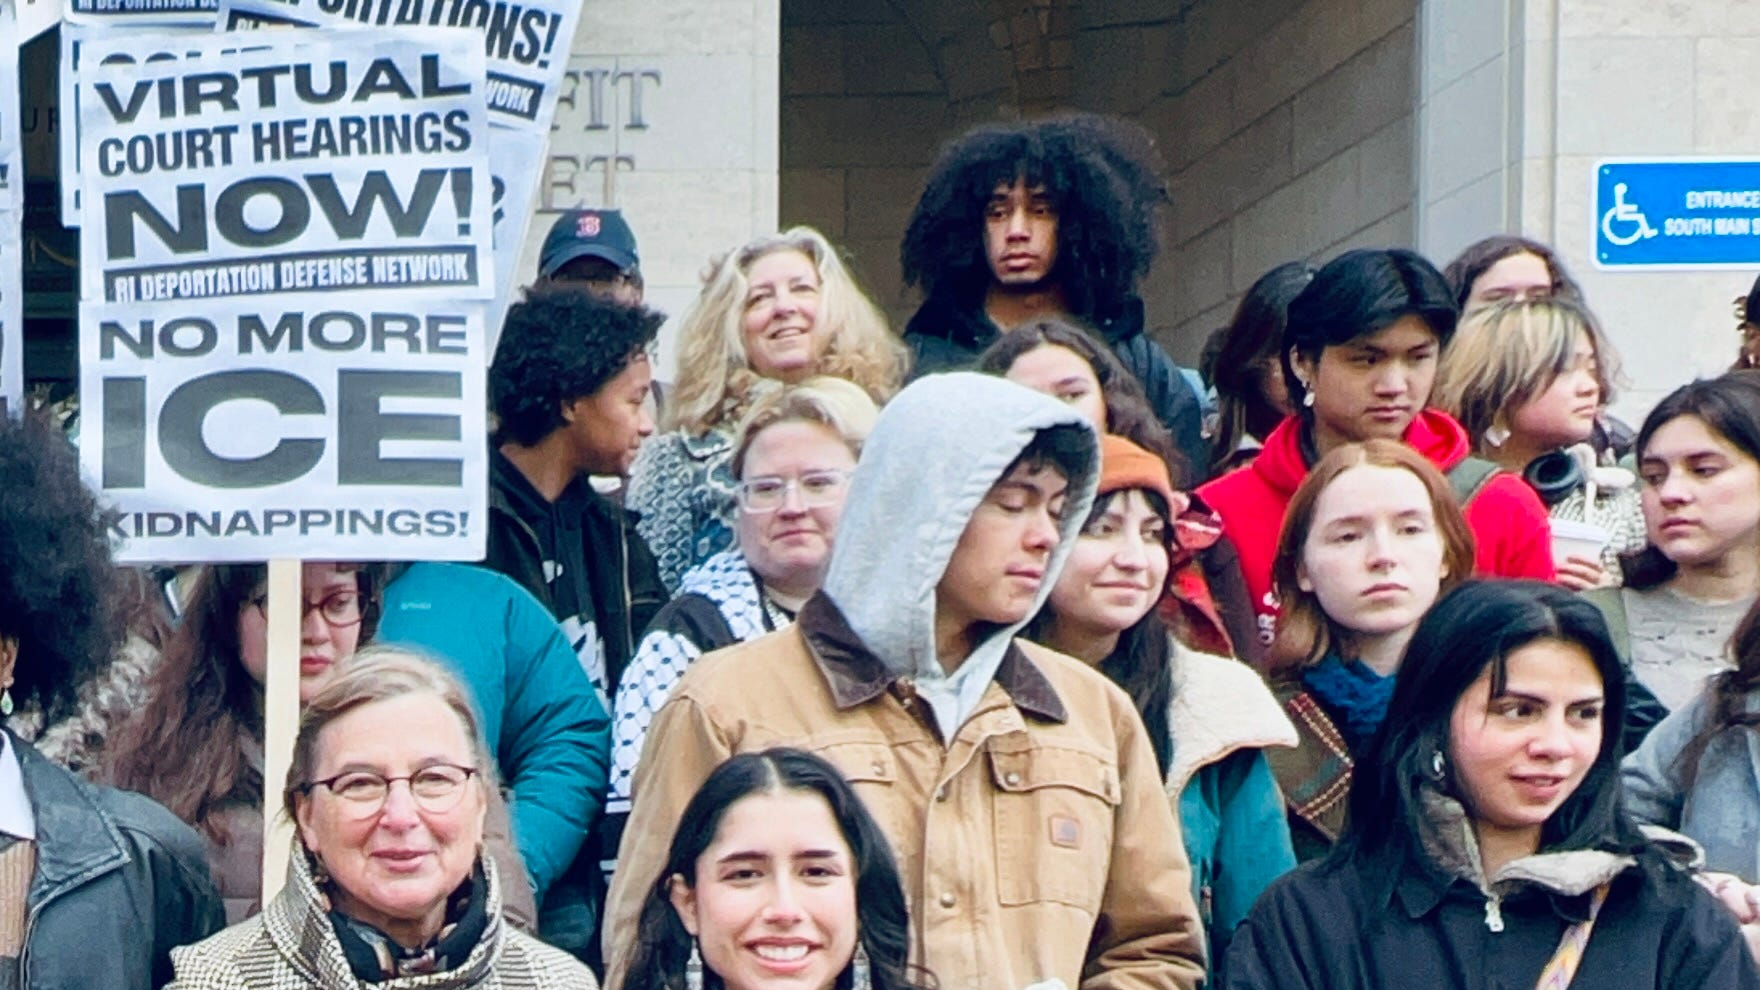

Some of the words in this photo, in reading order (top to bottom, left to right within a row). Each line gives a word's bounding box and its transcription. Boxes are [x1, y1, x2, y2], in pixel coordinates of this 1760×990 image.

[94, 54, 472, 125] VIRTUAL
[98, 124, 238, 177] COURT
[253, 109, 472, 164] HEARINGS
[103, 167, 475, 261] NOW!
[1664, 217, 1713, 236] SOUTH
[141, 262, 275, 301] DEPORTATION
[280, 256, 368, 289] DEFENSE
[372, 252, 469, 284] NETWORK
[100, 318, 218, 361] NO
[238, 311, 468, 355] MORE
[102, 368, 464, 489] ICE
